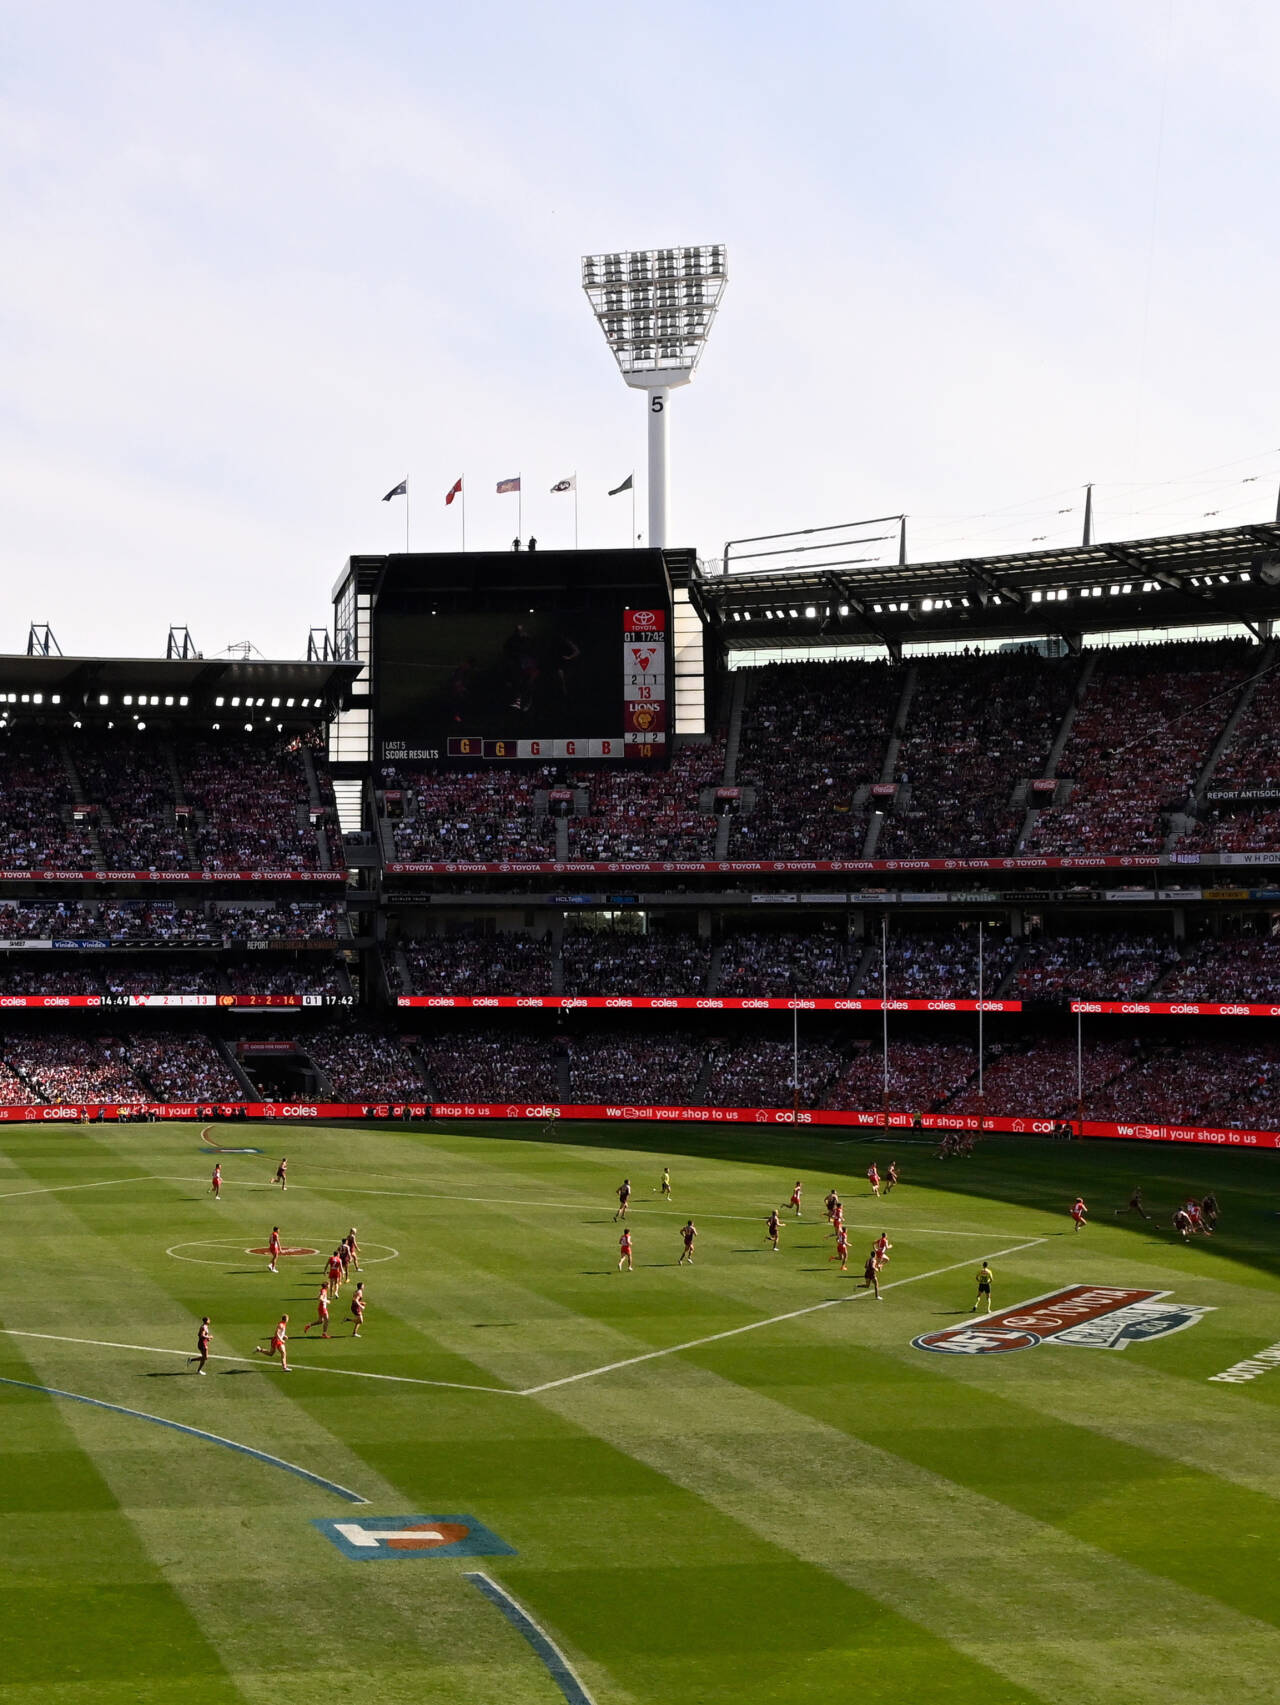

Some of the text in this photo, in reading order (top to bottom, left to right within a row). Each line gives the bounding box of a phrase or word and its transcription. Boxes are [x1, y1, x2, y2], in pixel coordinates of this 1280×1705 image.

[651, 395, 664, 413] 5
[632, 674, 637, 685] 2
[638, 686, 651, 699] 13
[629, 703, 660, 712] LIONS
[632, 733, 658, 743] 2 2
[385, 741, 400, 749] LAST
[460, 739, 611, 755] G G G G B
[638, 744, 651, 757] 14
[385, 750, 439, 759] SCORE RESULTS
[1207, 791, 1238, 799] REPORT
[1, 997, 26, 1007] coles
[101, 996, 129, 1005] 14:49
[326, 996, 353, 1005] 17:42
[429, 997, 956, 1010] coles coles coles coles coles
[1072, 1002, 1249, 1015] coles coles coles
[43, 1106, 78, 1119] coles
[282, 1104, 318, 1117] coles
[435, 1105, 490, 1118] shop to us
[525, 1105, 561, 1117] coles
[655, 1108, 679, 1120] your
[682, 1108, 709, 1121] shop
[711, 1109, 723, 1120] to
[726, 1111, 739, 1120] us
[909, 1116, 934, 1128] yur
[937, 1115, 962, 1129] shop
[967, 1117, 979, 1128] to
[1170, 1129, 1194, 1142] your
[1197, 1129, 1225, 1144] shop
[1229, 1131, 1240, 1143] to
[1243, 1134, 1257, 1144] us
[1033, 1289, 1137, 1316] TOYOTA
[933, 1330, 1021, 1353] AFL
